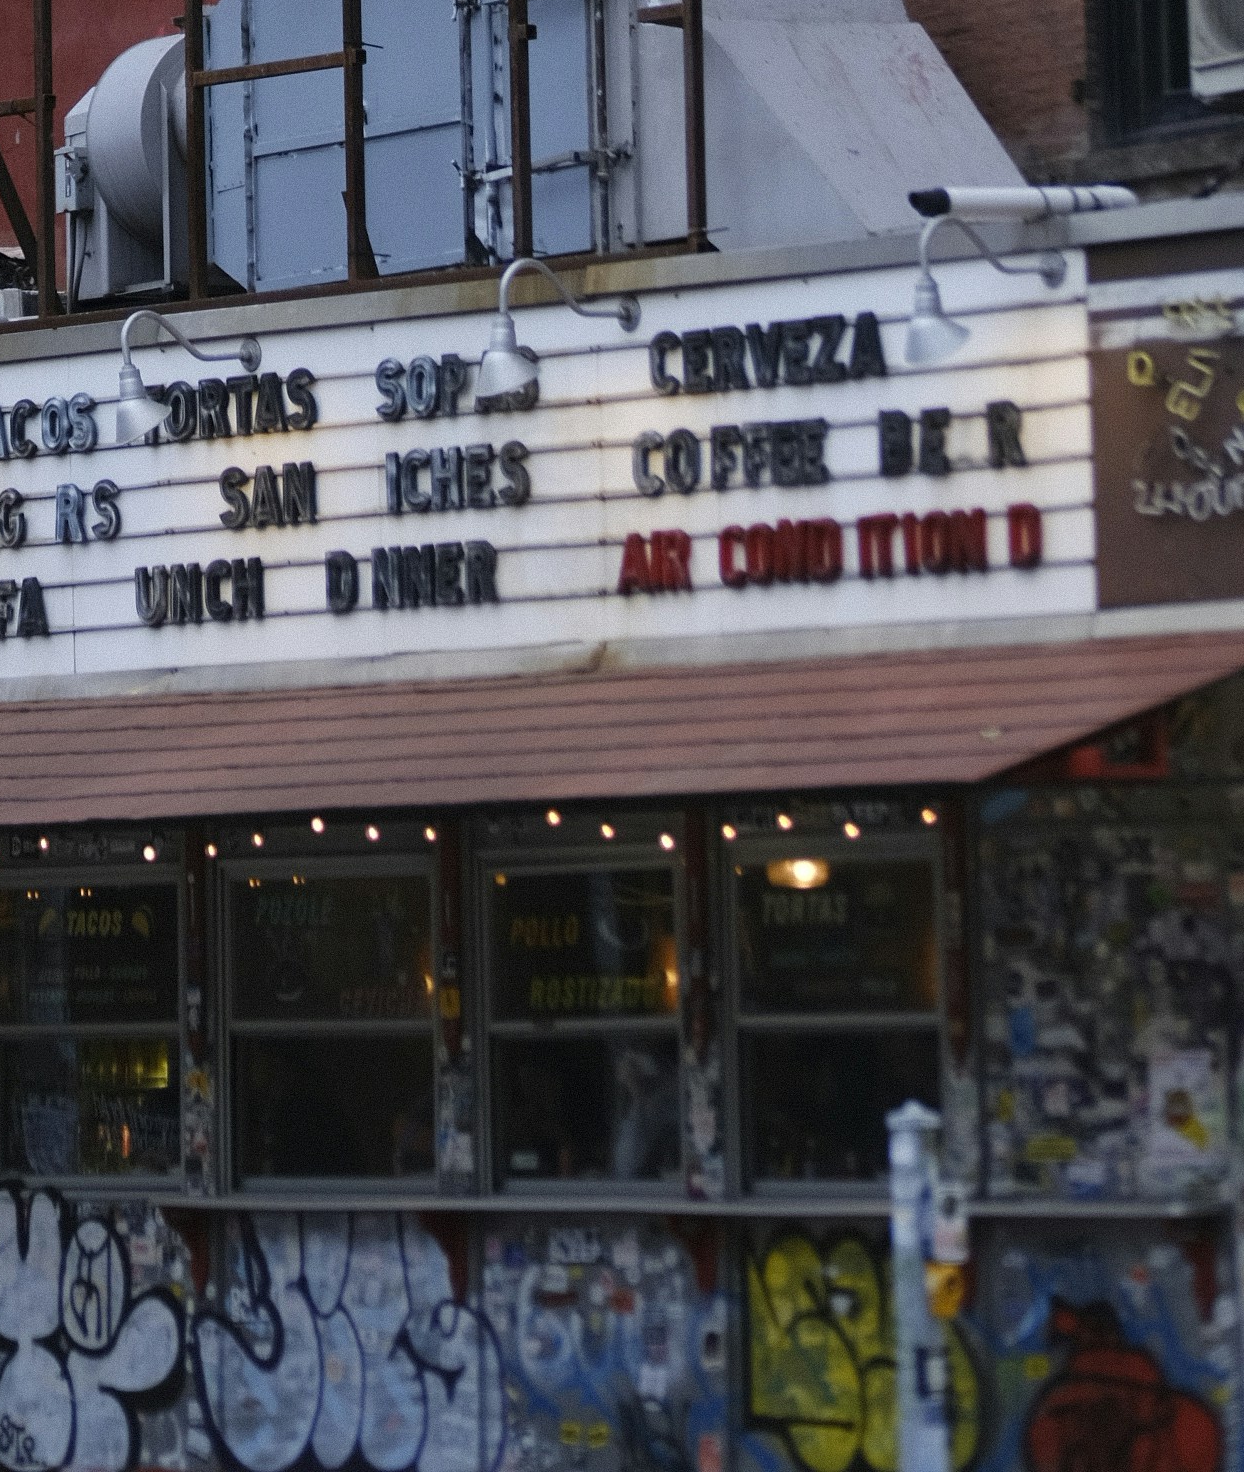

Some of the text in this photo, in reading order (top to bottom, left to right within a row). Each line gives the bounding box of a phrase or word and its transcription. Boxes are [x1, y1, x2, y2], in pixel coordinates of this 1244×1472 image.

[374, 344, 540, 424] SOPS
[649, 311, 887, 397] CERVEZA
[632, 418, 830, 498] COFFEE
[66, 909, 124, 938] TACOS
[510, 913, 580, 946] POLLO
